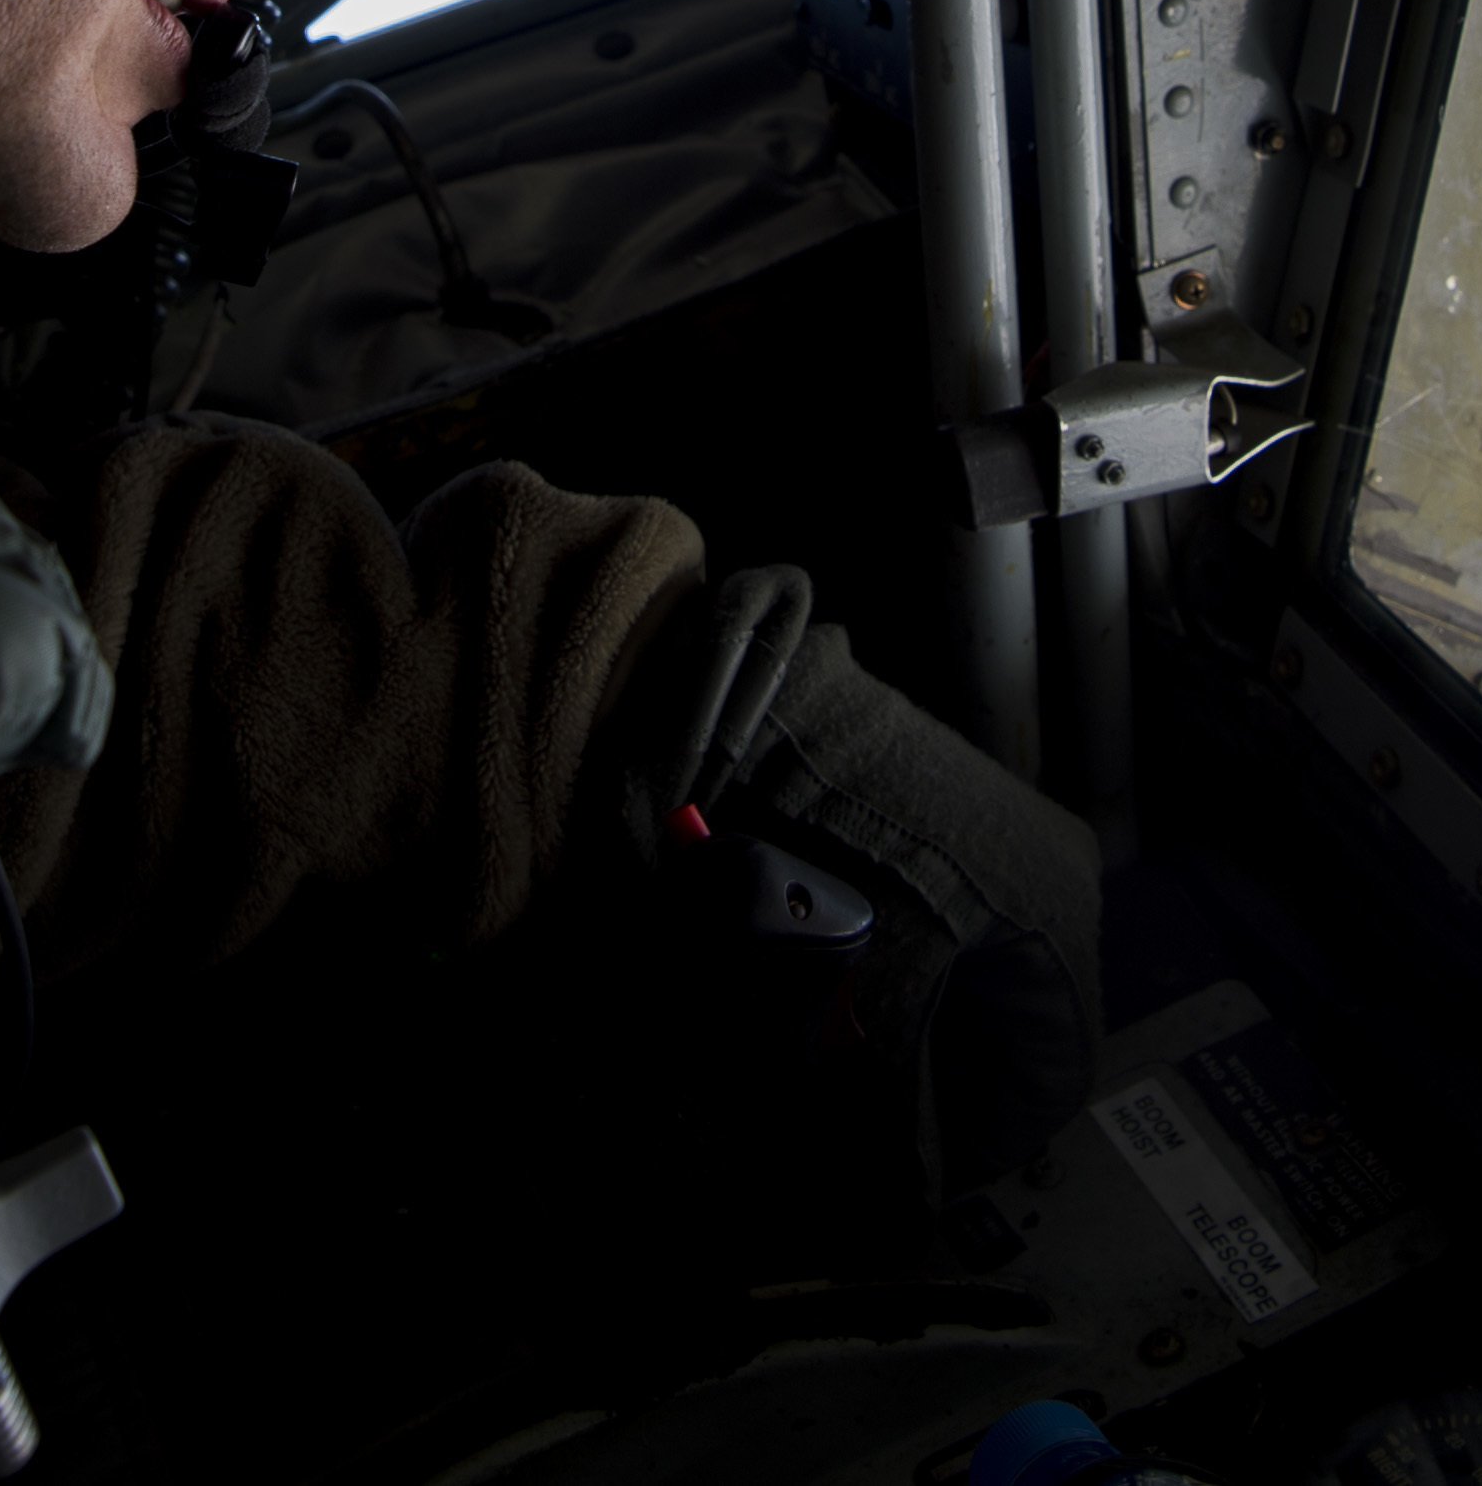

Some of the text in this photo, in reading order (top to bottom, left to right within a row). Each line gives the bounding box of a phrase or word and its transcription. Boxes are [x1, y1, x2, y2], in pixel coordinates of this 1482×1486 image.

[1110, 1106, 1162, 1160] HOIST
[1133, 1093, 1187, 1150] BOOM
[1197, 1051, 1226, 1082] AND
[1240, 1108, 1286, 1160] MASTER
[1282, 1162, 1326, 1211] SWITCH
[1326, 1215, 1351, 1238] ON
[1226, 1054, 1278, 1114] WITHOUT
[1322, 1176, 1366, 1222] POWER
[1185, 1202, 1279, 1315] TELESCOPE
[1226, 1214, 1284, 1275] BOOM
